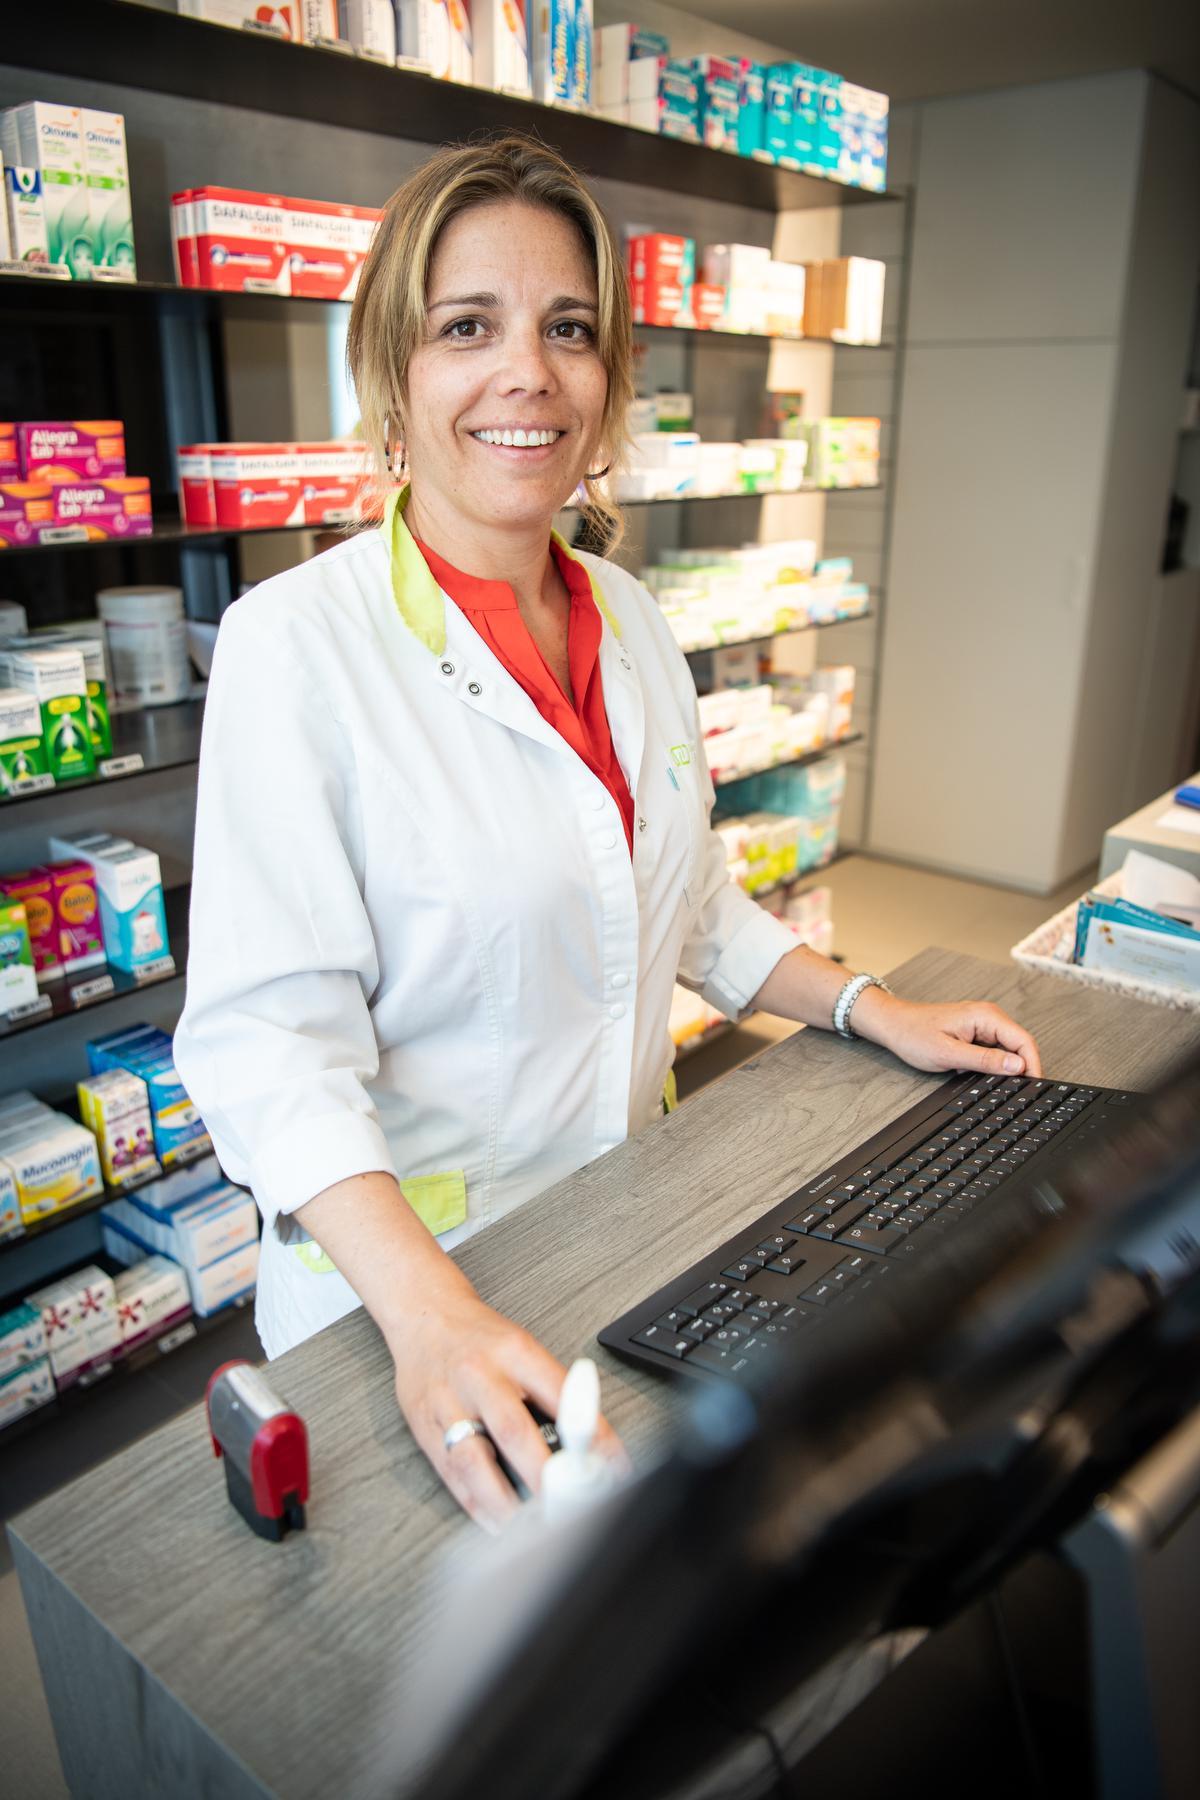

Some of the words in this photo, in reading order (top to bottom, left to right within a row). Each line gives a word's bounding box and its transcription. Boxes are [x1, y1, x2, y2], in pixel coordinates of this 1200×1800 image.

[31, 429, 78, 447] Allegra
[58, 488, 105, 506] Allegra
[21, 1143, 93, 1181] Mucoangin
